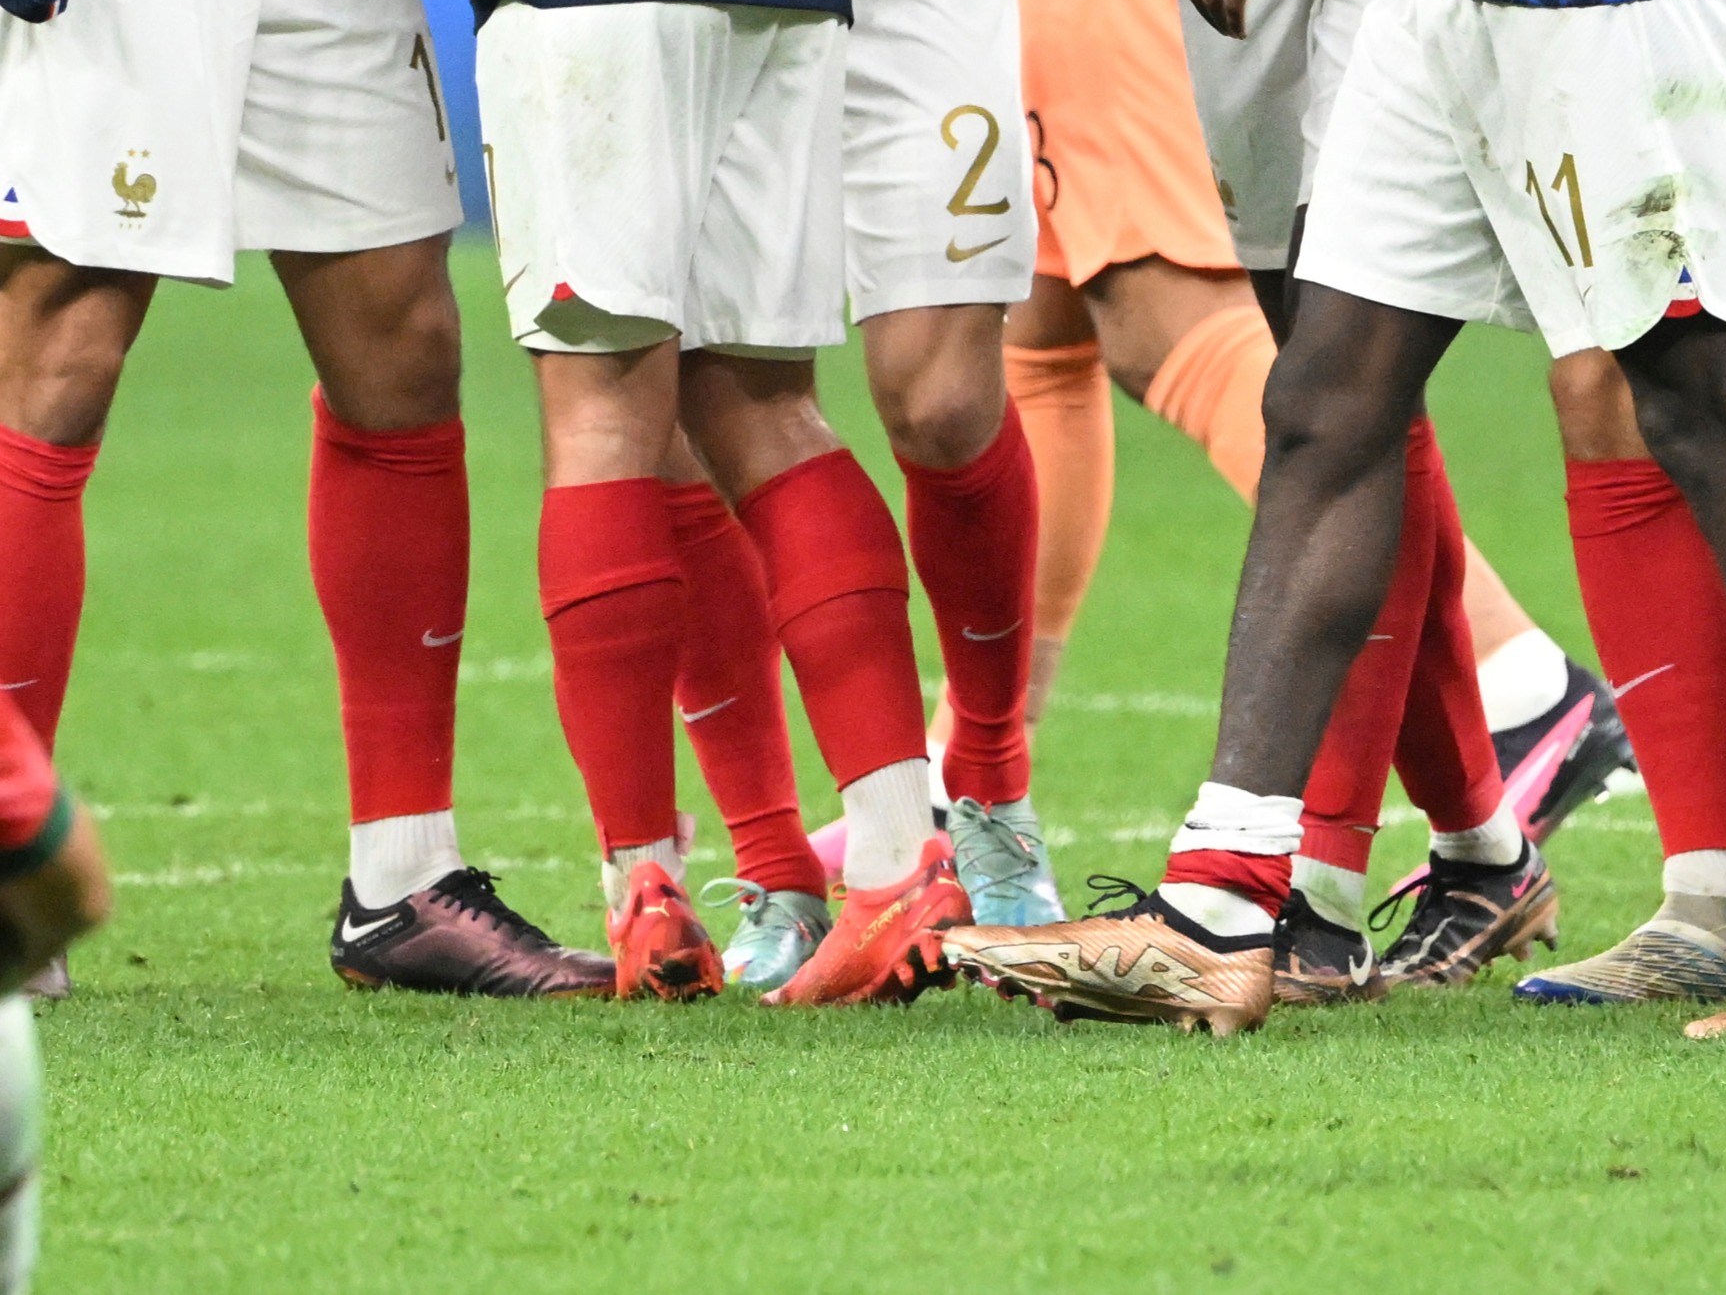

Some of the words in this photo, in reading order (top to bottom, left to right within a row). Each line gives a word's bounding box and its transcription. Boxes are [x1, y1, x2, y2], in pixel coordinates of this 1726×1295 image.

[940, 104, 1011, 217] 2
[1525, 152, 1594, 269] 11
[853, 901, 902, 952] ULTRA
